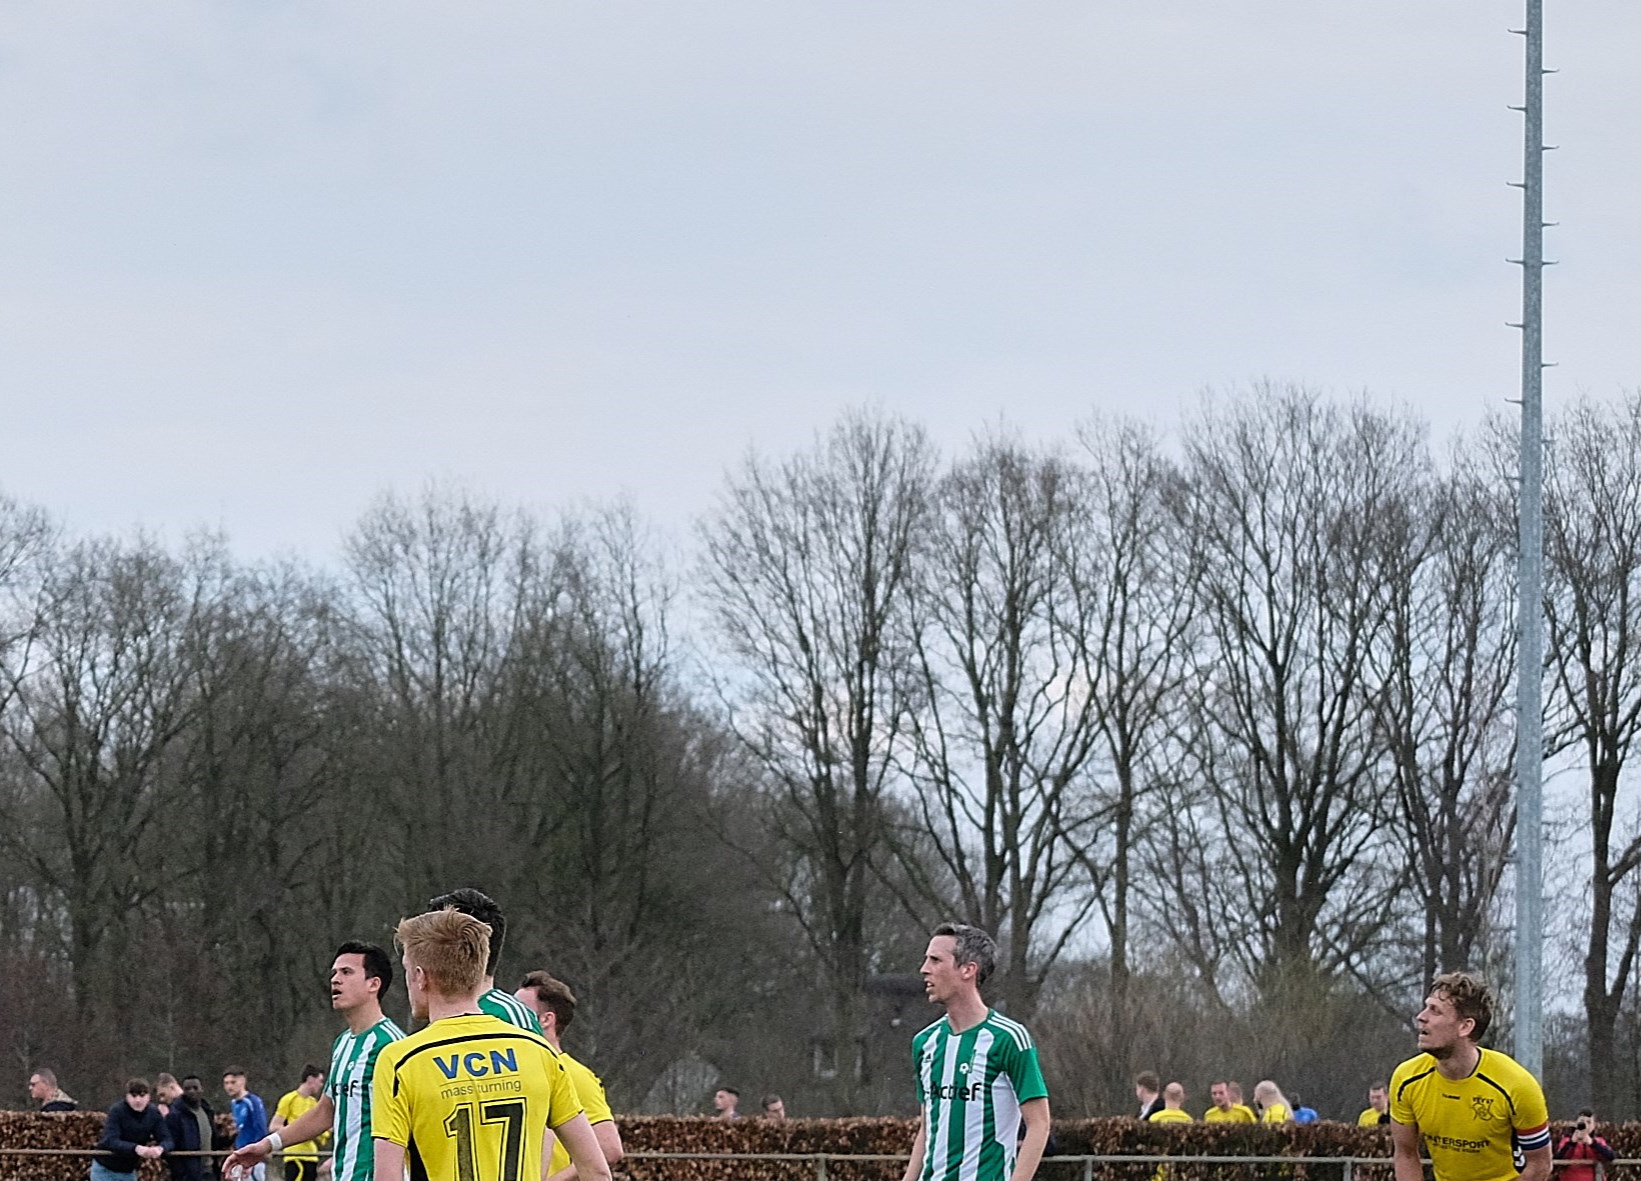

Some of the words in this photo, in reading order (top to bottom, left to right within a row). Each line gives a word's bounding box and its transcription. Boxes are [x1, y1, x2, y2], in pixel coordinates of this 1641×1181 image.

[433, 1048, 519, 1079] VCN
[441, 1086, 473, 1099] mass
[477, 1080, 521, 1093] turning
